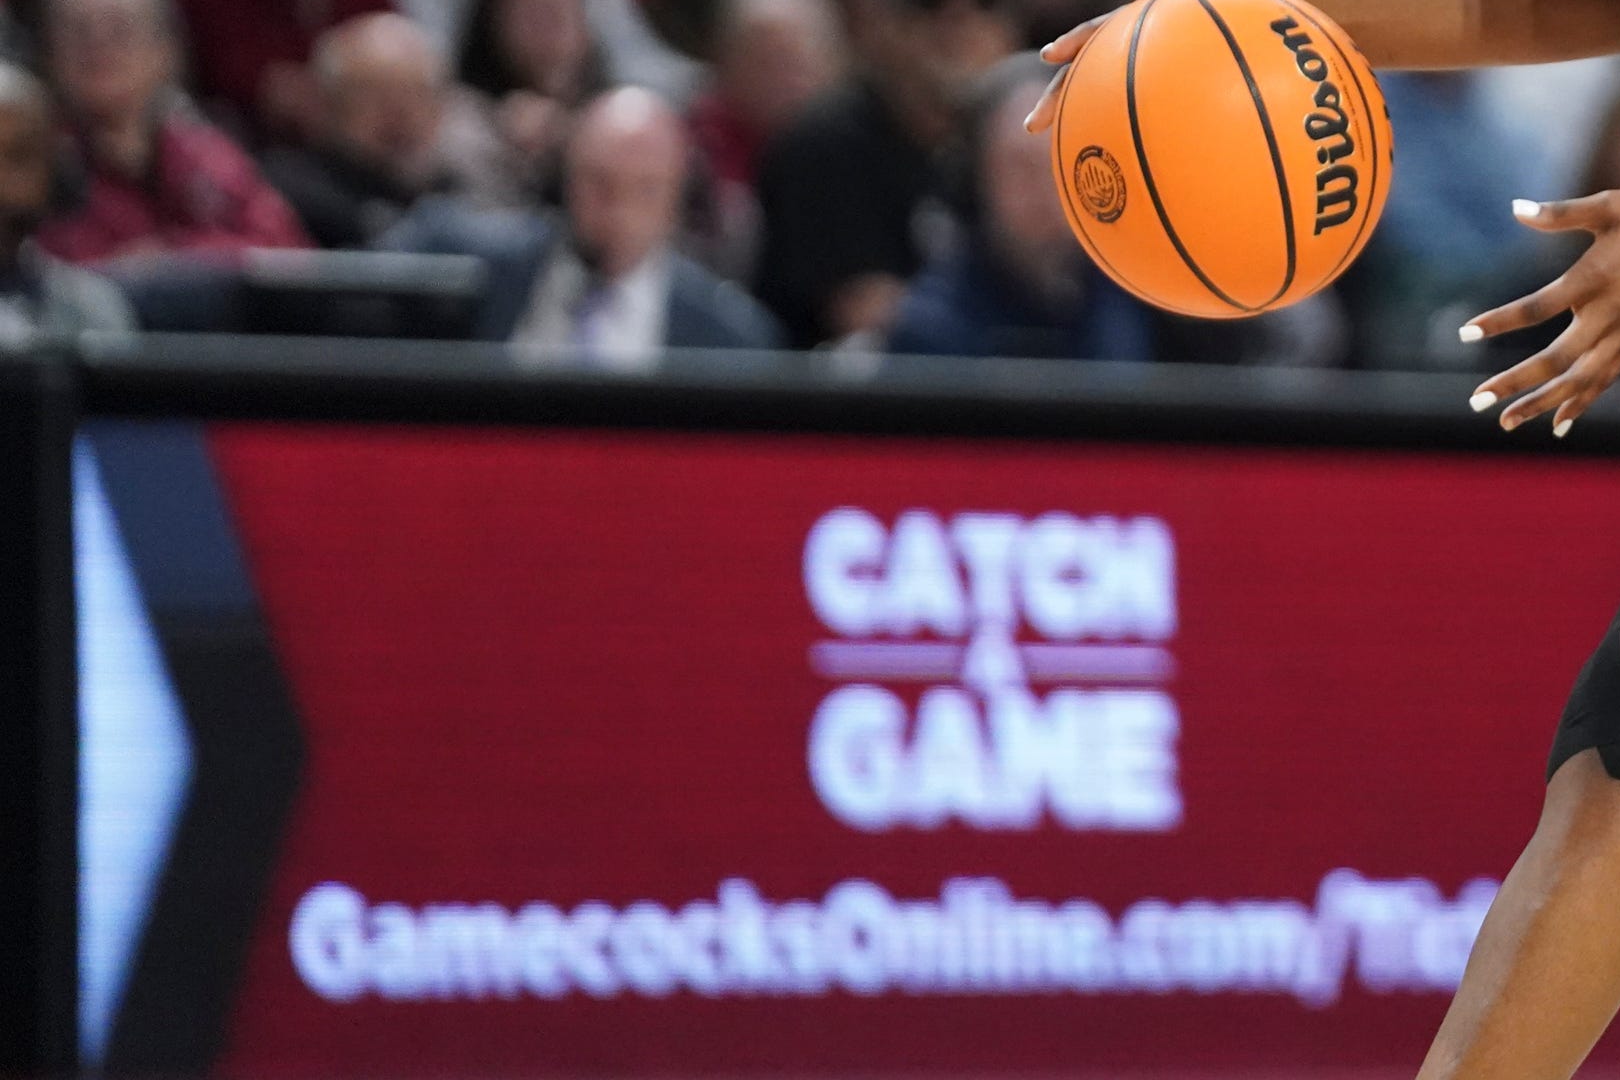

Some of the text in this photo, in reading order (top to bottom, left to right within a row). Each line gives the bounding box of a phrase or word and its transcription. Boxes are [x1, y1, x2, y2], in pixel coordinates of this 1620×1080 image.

[1270, 14, 1358, 236] Wilson
[804, 506, 1180, 640] CATCH
[807, 683, 1183, 832] GAME
